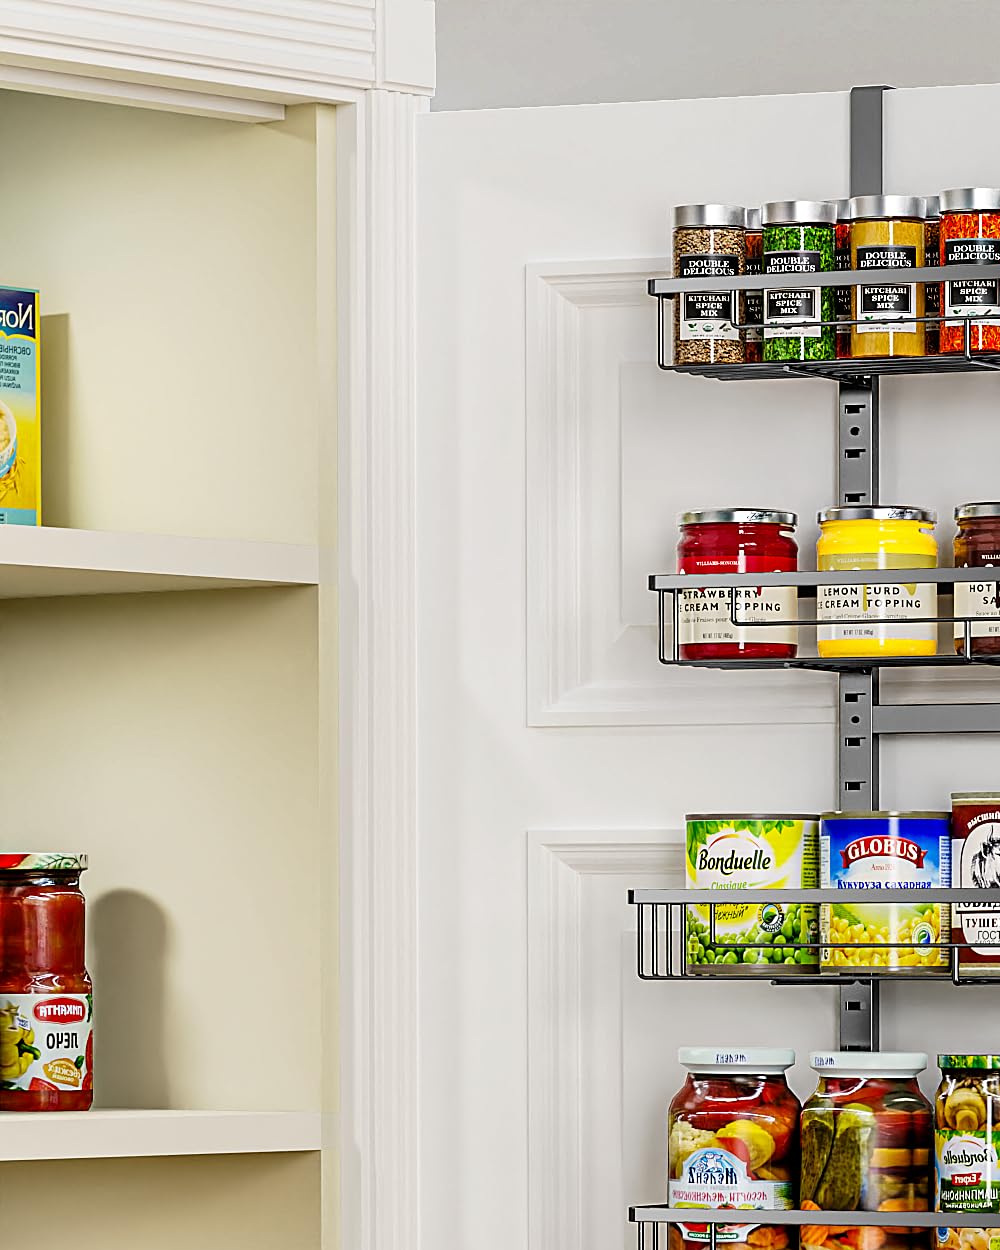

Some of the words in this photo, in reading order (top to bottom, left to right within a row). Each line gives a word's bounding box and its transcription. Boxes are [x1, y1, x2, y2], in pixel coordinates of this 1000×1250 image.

[953, 245, 995, 253] DOUBLE
[865, 252, 907, 260] DOUBLE
[948, 252, 1000, 260] DELICIOUS
[689, 260, 730, 268] DOUBLE
[770, 257, 810, 265] DOUBLE
[860, 259, 912, 268] DELICIOUS
[683, 267, 735, 276] DELICIOUS
[766, 265, 816, 273] DELICIOUS
[953, 280, 996, 288] KITCHARI
[864, 287, 907, 295] KITCHARI
[770, 292, 811, 300] KITCHARI
[871, 294, 899, 302] SPICE
[964, 295, 983, 303] MIX
[700, 309, 718, 317] MIX
[823, 587, 858, 596] LEMON
[866, 587, 900, 595] CURD
[969, 584, 992, 593] HOT
[684, 602, 719, 612] CREAM
[825, 600, 859, 608] CREAM
[867, 599, 921, 608] TOPPING
[967, 811, 1000, 829] ВЫСШИЙ
[848, 838, 918, 861] GLOBUS
[698, 848, 771, 875] Bonduelle
[711, 881, 747, 890] Classique
[838, 880, 882, 889] Кукуруза
[885, 881, 931, 889] сахарная
